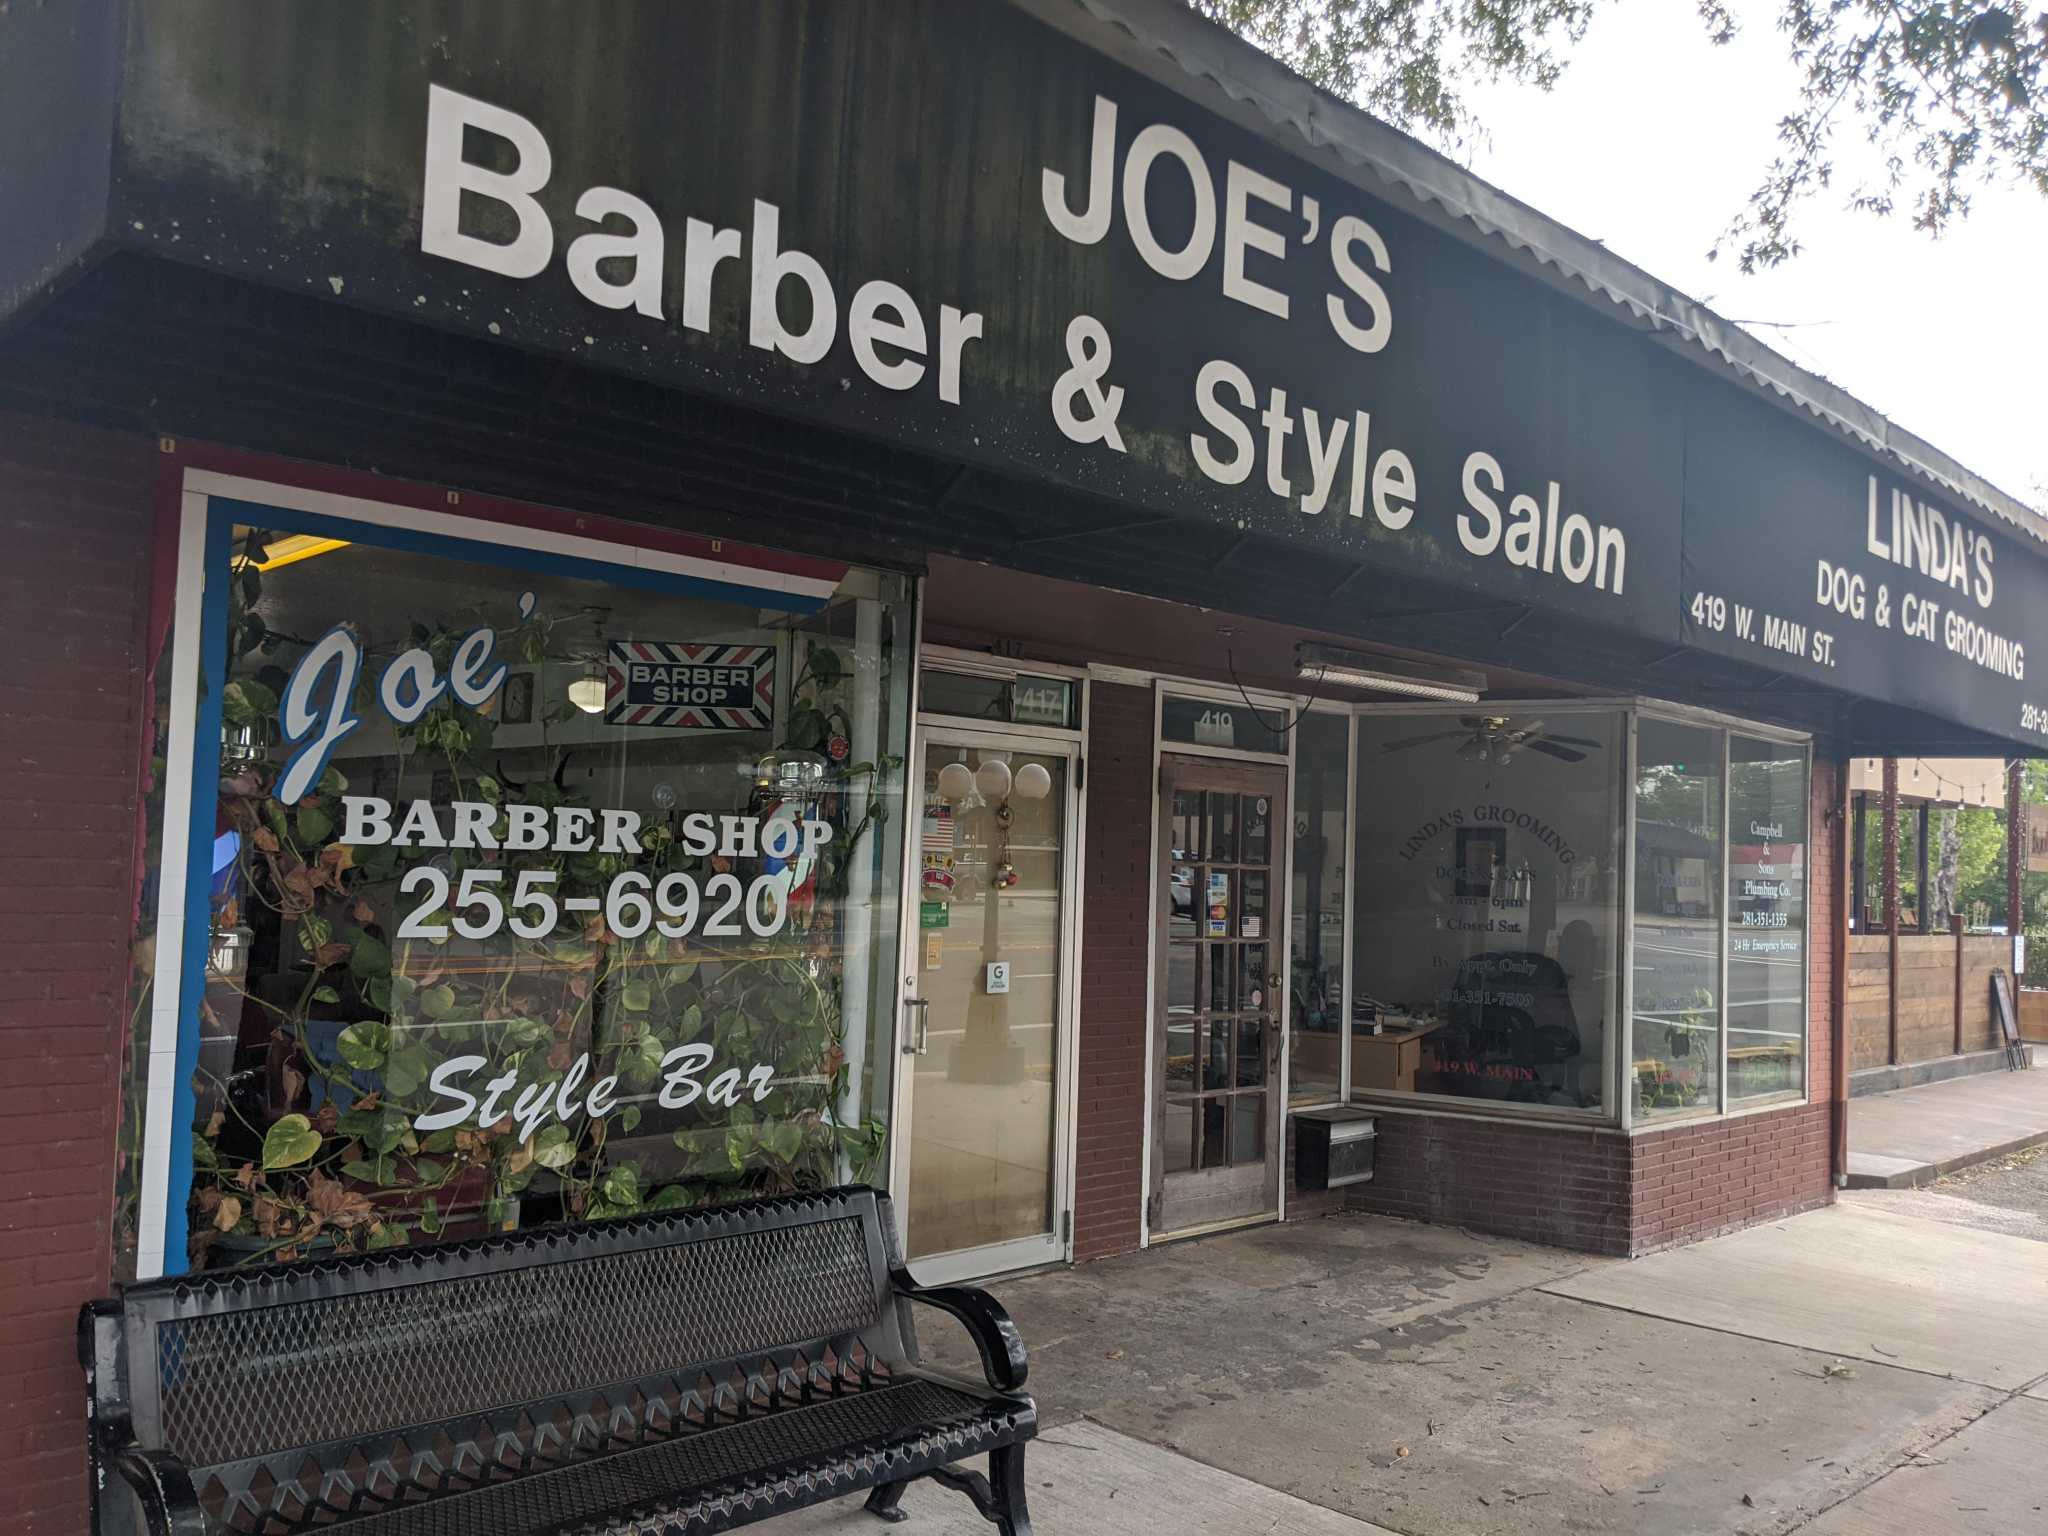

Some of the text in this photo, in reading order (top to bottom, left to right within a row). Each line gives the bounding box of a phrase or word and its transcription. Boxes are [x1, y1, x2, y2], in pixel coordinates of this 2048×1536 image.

[1042, 94, 1392, 353] JOE'S
[420, 83, 1627, 596] Barber & Style Salon
[1867, 474, 1994, 608] LINDA'S
[1690, 591, 1835, 668] 419 W. MAIN ST.
[1816, 559, 2025, 681] DOG & CAT GROOMING
[631, 665, 750, 687] BARBER
[652, 685, 728, 704] SHOP
[338, 794, 834, 861] BARBER SHOP
[1399, 807, 1465, 861] LINDA'S
[1473, 804, 1576, 865] GROOMING
[1750, 820, 1783, 840] Campbell
[1762, 842, 1771, 856] &
[395, 866, 788, 940] 255-6920
[1741, 911, 1788, 928] 281-351-1355
[1744, 880, 1792, 899] Plumbing Co.
[1446, 917, 1522, 934] Closed Sat.
[1733, 940, 1742, 952] 24
[412, 1042, 776, 1146] Style Bar
